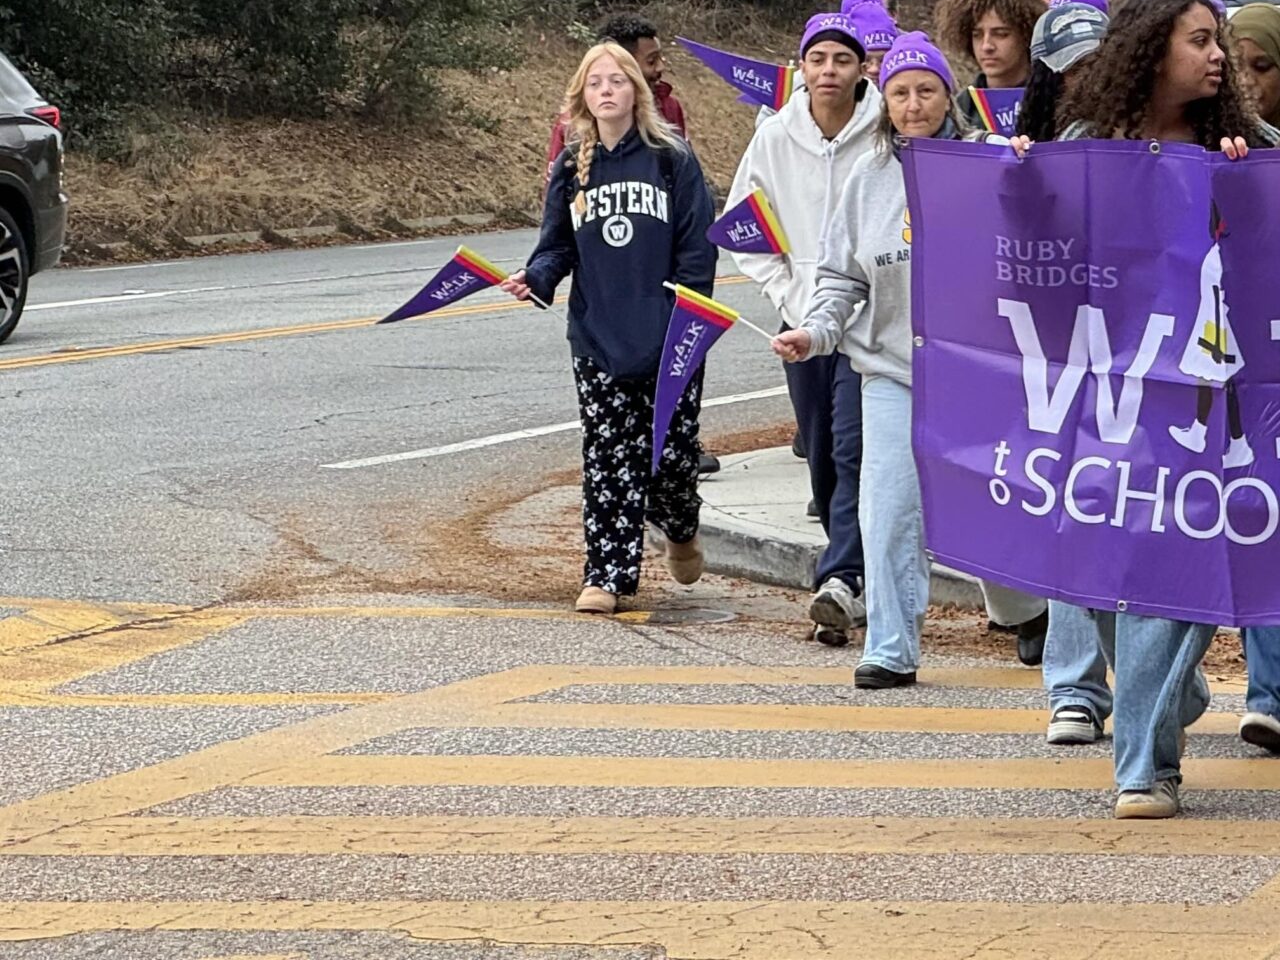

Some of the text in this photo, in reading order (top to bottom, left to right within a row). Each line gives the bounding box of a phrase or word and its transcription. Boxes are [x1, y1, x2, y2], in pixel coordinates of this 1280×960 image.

[885, 50, 929, 70] WALK
[732, 66, 774, 93] WALK
[609, 223, 626, 240] W
[726, 221, 762, 243] WALK
[874, 252, 893, 267] WE
[995, 235, 1075, 262] RUBY
[430, 272, 476, 301] WALK
[995, 262, 1119, 289] BRIDGES
[669, 321, 704, 377] WALK
